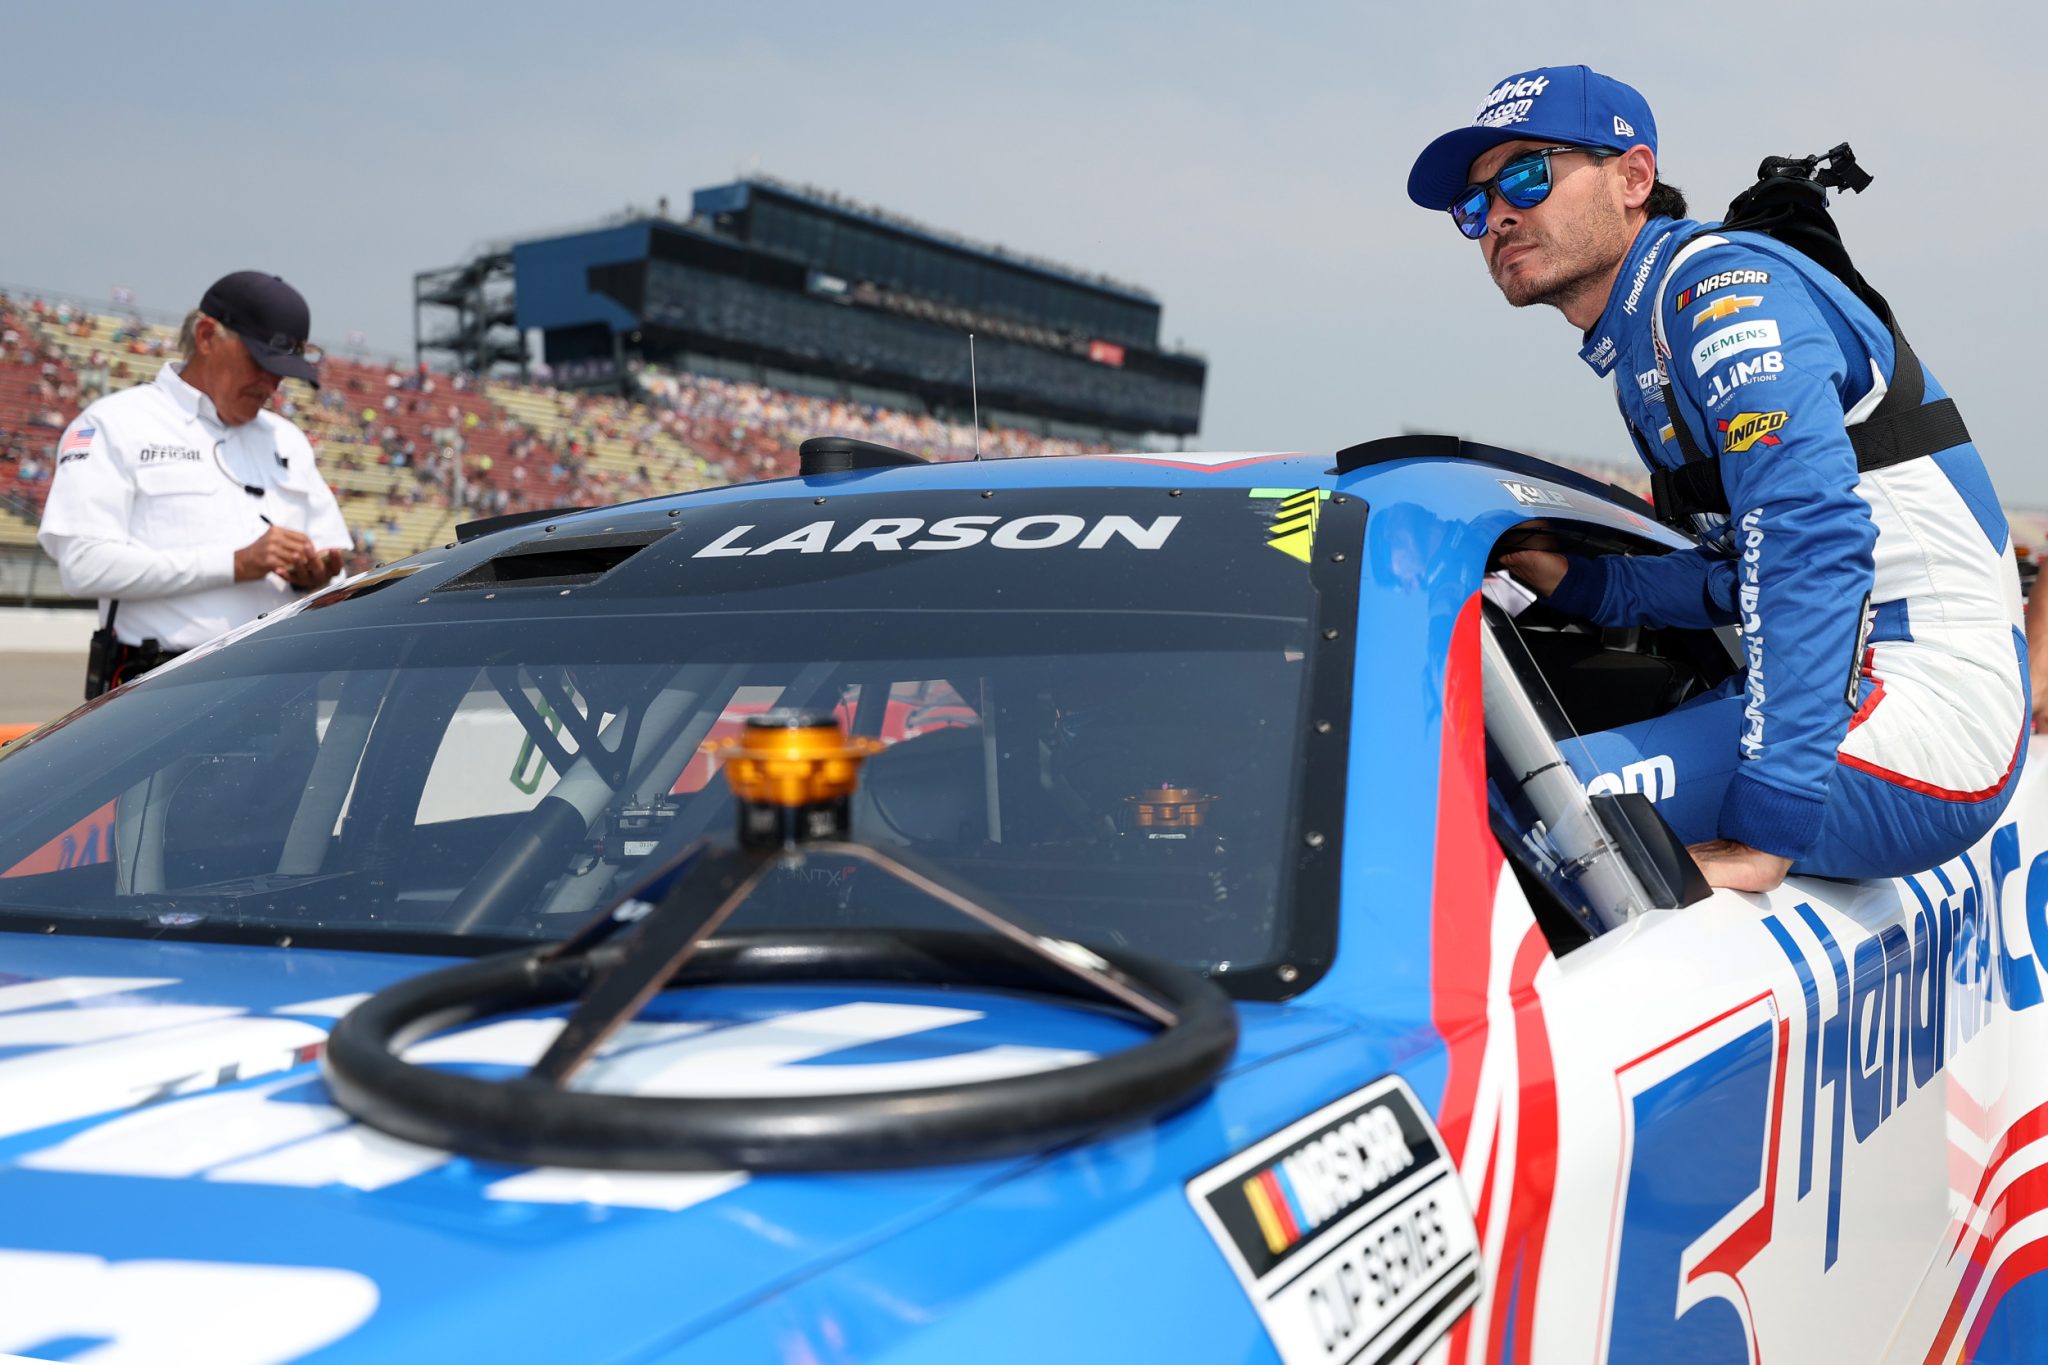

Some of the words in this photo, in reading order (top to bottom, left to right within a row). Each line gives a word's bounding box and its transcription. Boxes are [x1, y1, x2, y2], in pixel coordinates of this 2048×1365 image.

[1695, 270, 1769, 299] NASCAR
[1699, 327, 1769, 363] SIEMENS
[1724, 413, 1784, 450] UNOCO
[139, 449, 203, 464] OFFICIAL
[691, 514, 1182, 559] LARSON
[1283, 1103, 1415, 1230] NASCAR
[1361, 1198, 1450, 1310] SERIES
